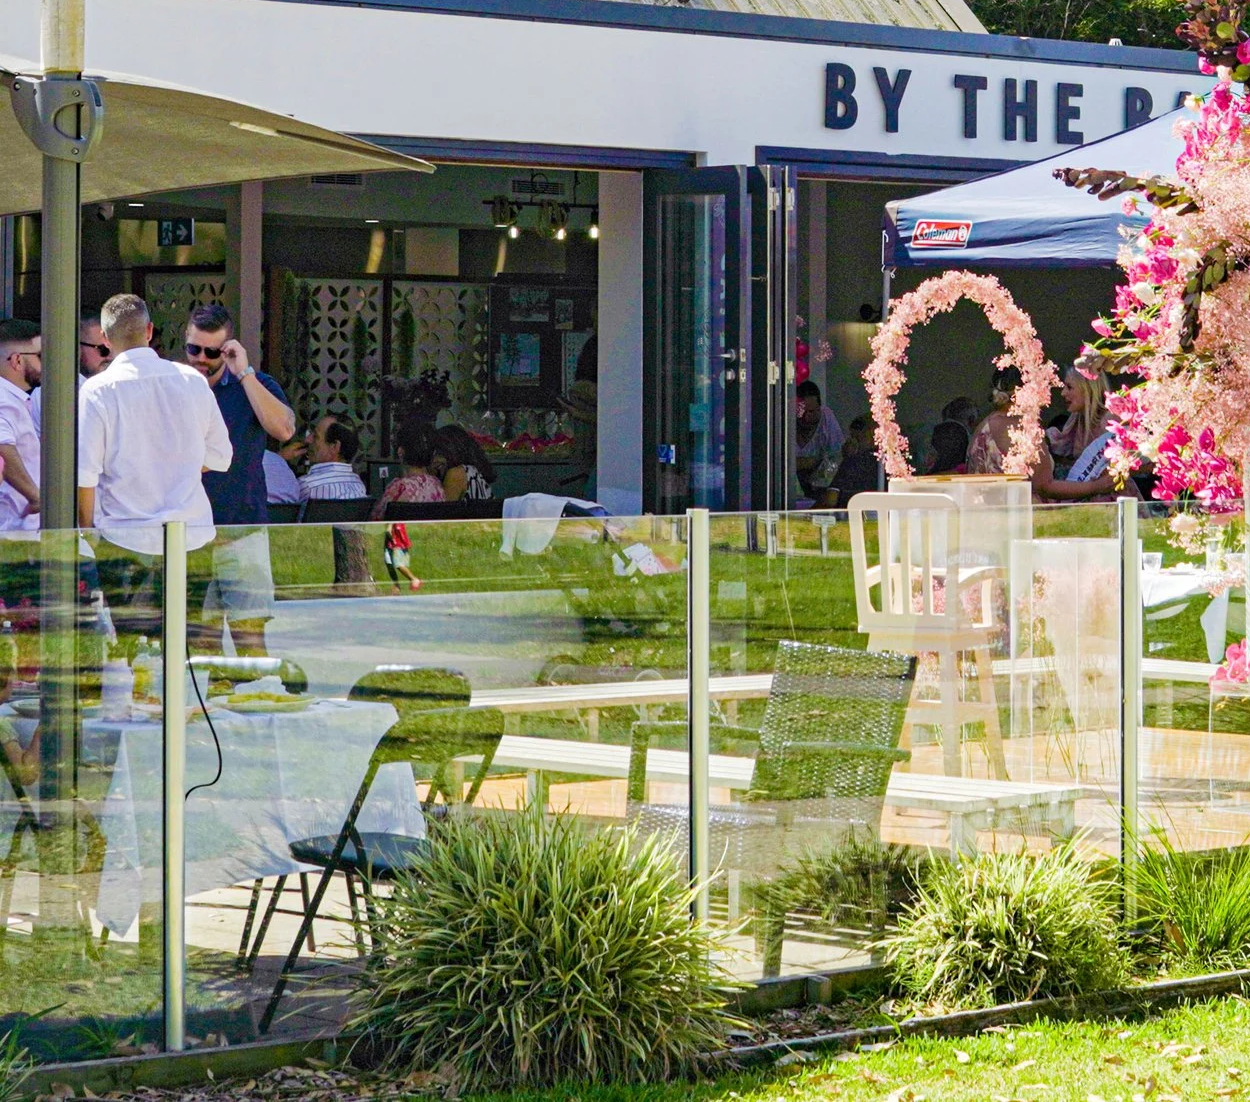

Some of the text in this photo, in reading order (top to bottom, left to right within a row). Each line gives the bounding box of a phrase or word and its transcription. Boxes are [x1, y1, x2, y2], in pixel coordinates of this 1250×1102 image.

[824, 62, 911, 133] BY
[954, 74, 1084, 144] THE
[916, 223, 958, 241] Coleman
